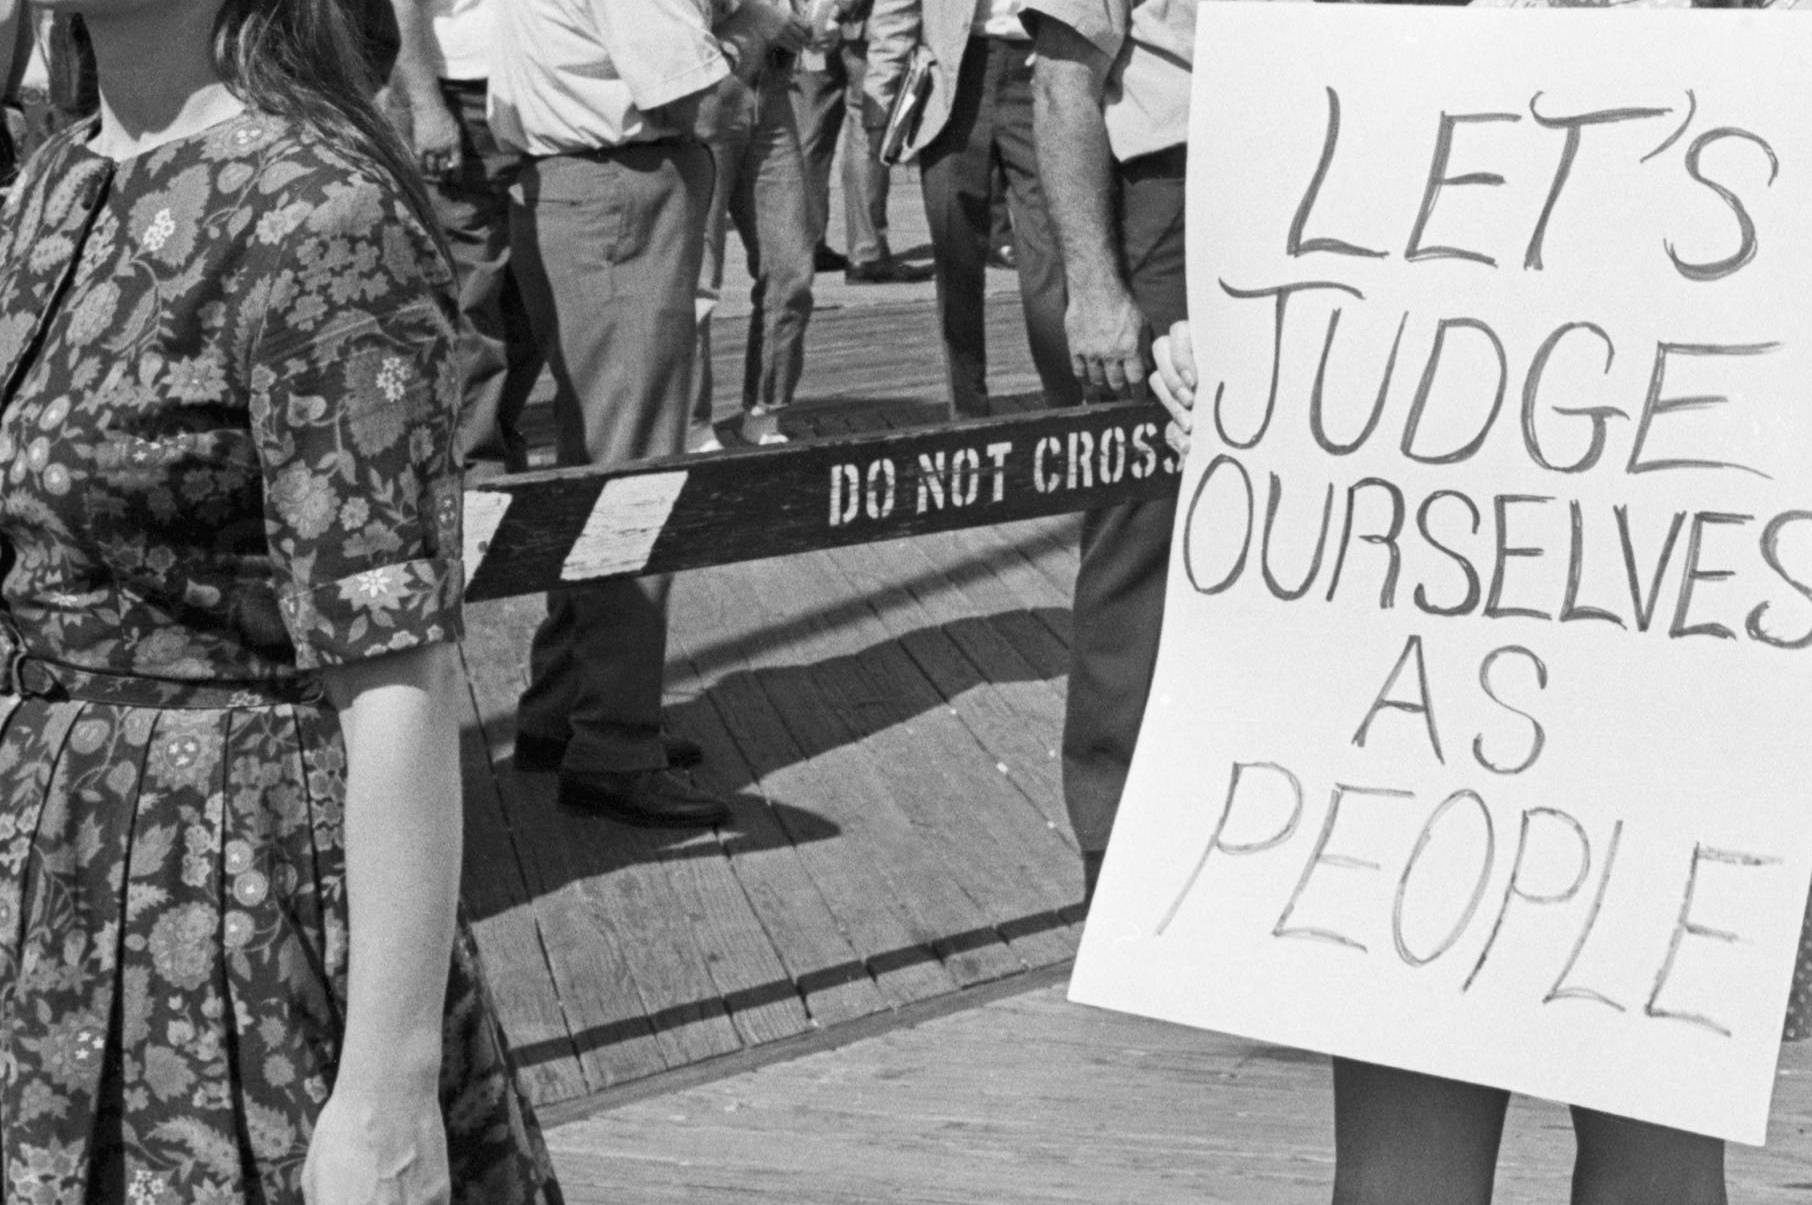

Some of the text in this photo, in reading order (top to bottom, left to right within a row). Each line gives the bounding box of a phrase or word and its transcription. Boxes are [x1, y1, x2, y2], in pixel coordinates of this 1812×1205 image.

[1287, 85, 1779, 281] LET'S
[828, 421, 1189, 527] DO NOT CROSS
[1213, 277, 1784, 481] JUDGE
[1352, 634, 1549, 775] AS
[1156, 760, 1786, 1039] PEOPLE
